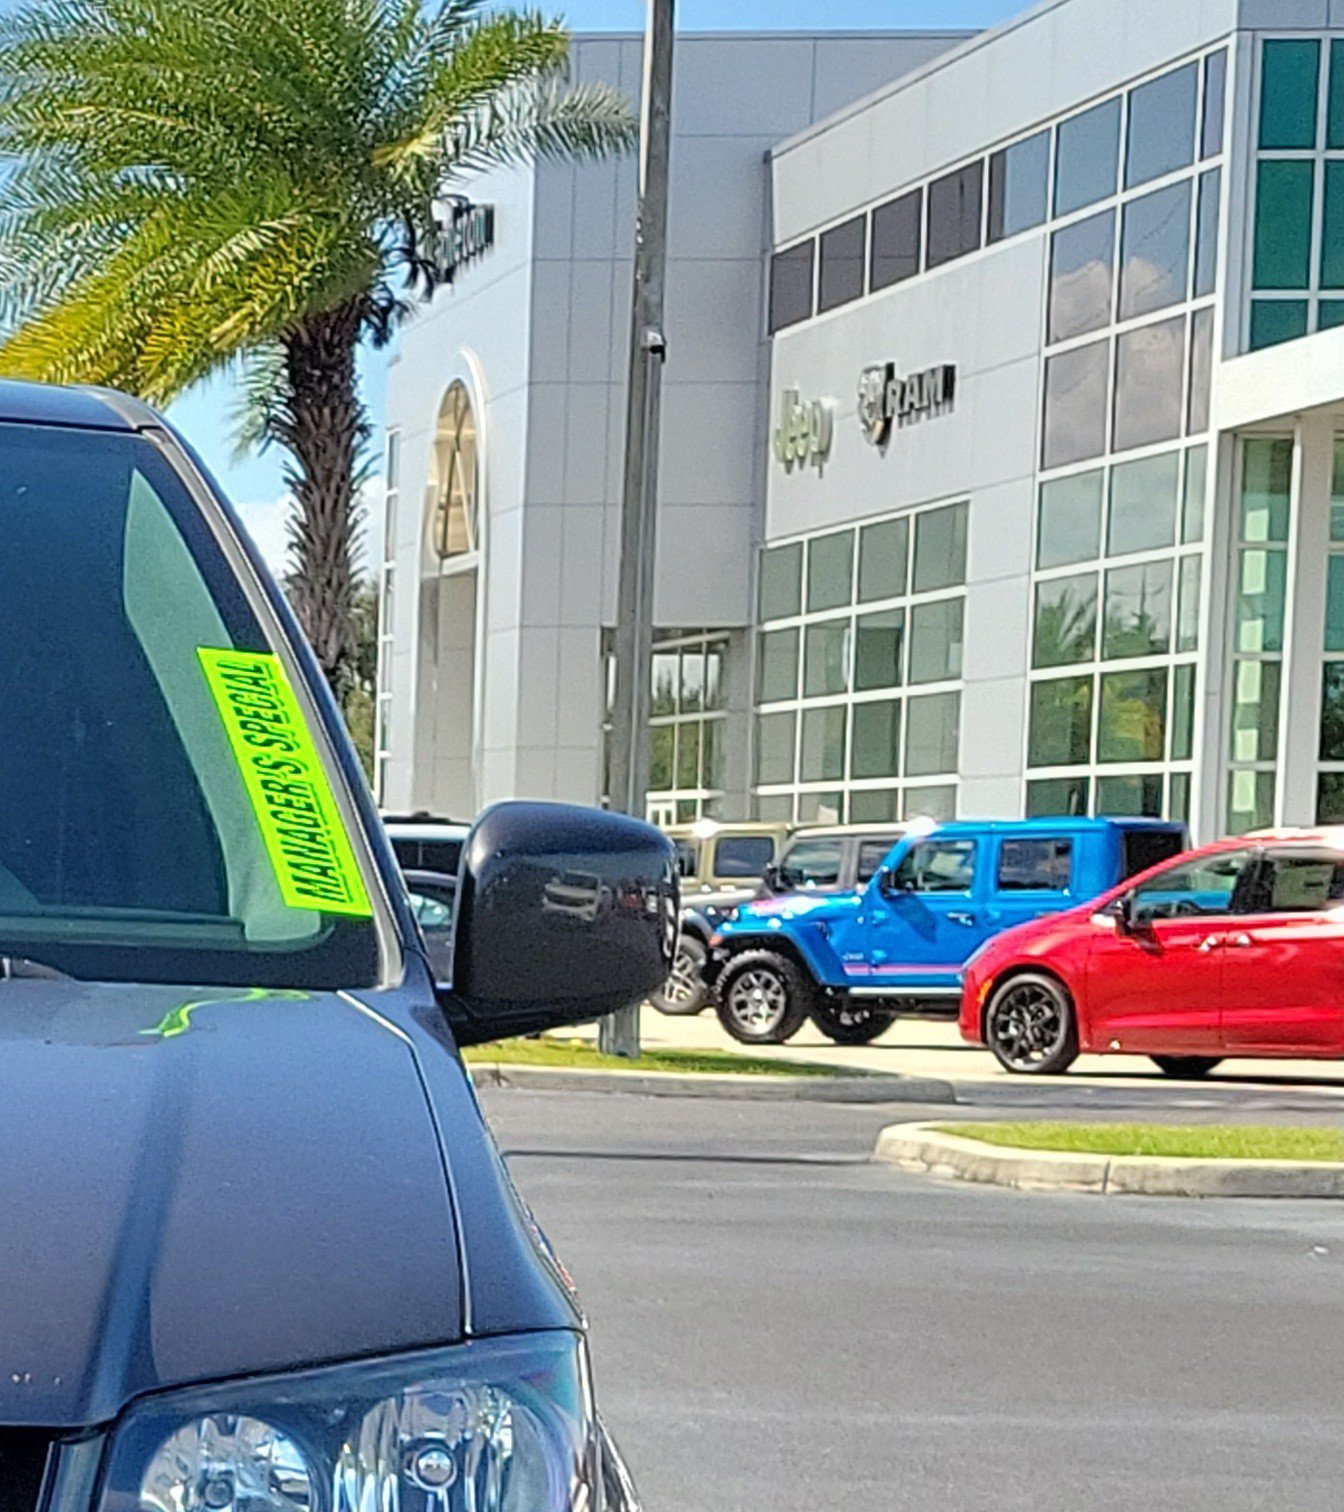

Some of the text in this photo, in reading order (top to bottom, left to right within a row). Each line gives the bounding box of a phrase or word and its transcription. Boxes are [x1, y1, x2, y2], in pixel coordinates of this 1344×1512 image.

[885, 364, 957, 420] RAM
[216, 660, 350, 904] MANAGER'S SPECIAL
